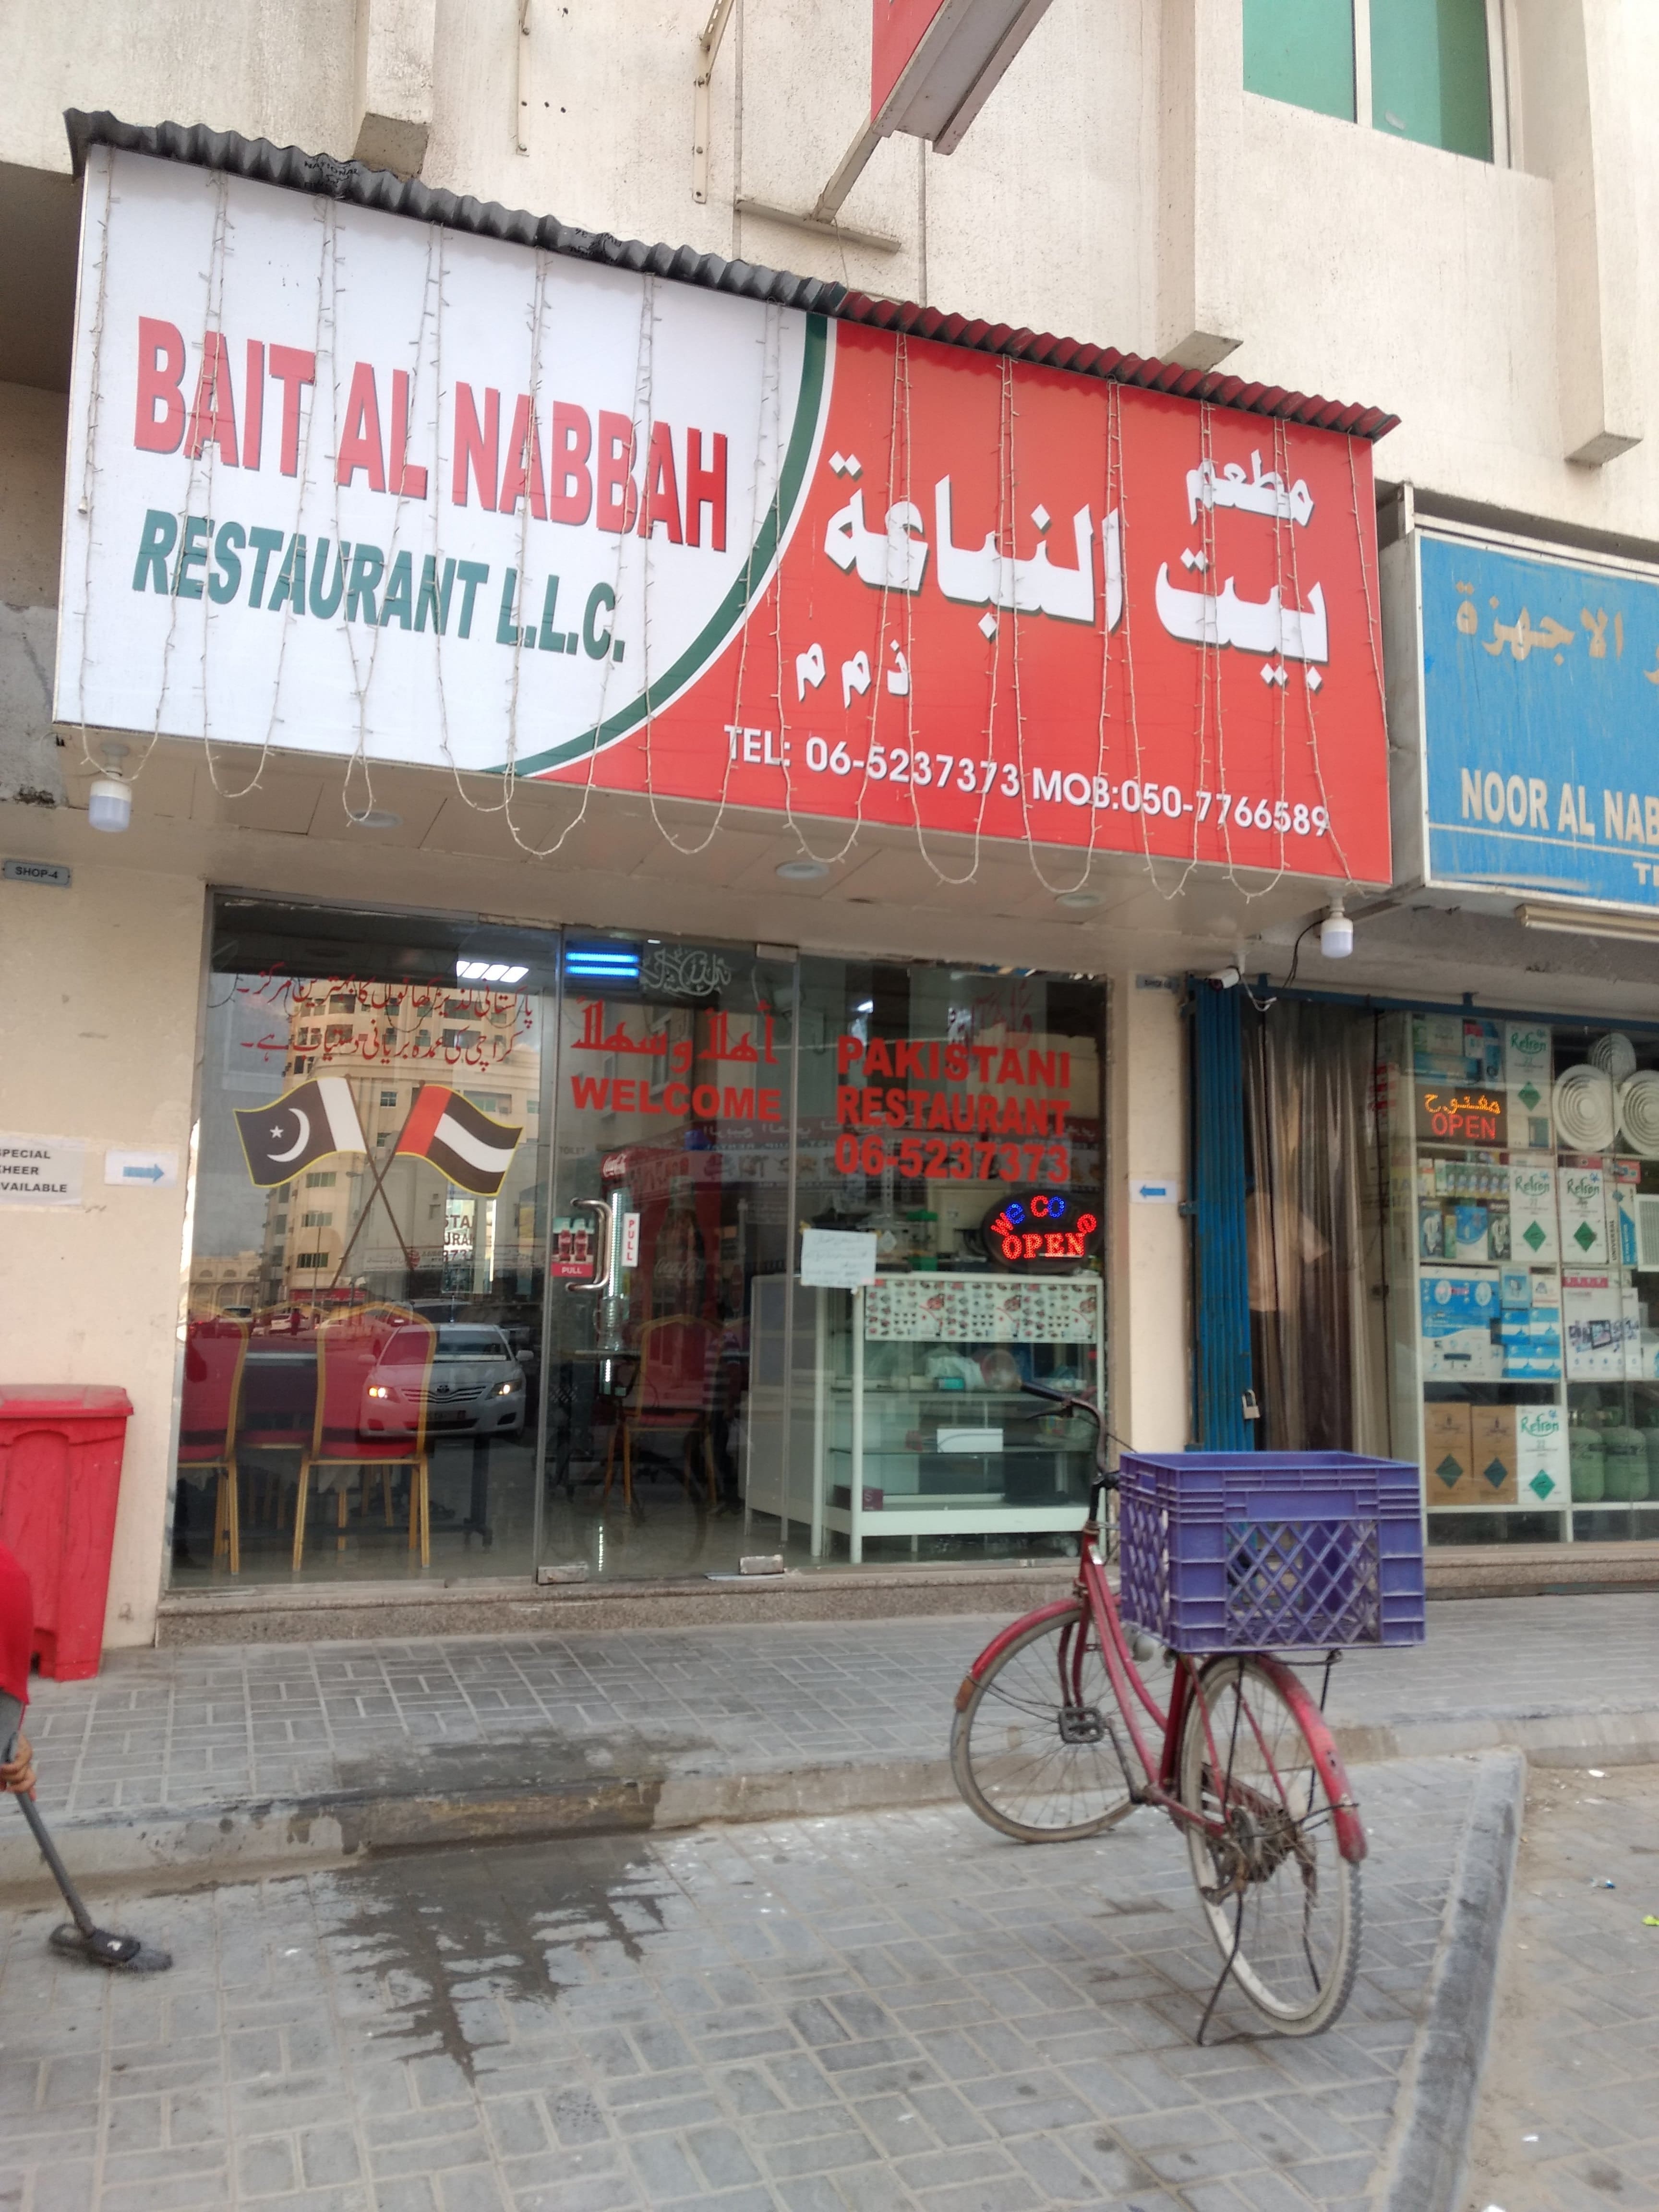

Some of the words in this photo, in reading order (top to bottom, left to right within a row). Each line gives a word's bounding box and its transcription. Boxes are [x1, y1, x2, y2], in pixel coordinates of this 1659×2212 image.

[133, 315, 317, 478] BAIT
[335, 361, 428, 500] AL
[452, 381, 728, 552] NABBAH
[1187, 448, 1314, 527] مطعم
[824, 450, 1122, 640] النباعة
[132, 509, 490, 639] RESTAURANT
[495, 567, 625, 663] L.L.C.
[1155, 547, 1328, 692] بيت
[724, 724, 791, 767] TEL:
[805, 736, 1021, 797] 06-5237373
[1461, 768, 1550, 831] NOOR
[1557, 782, 1595, 837] AL
[1604, 789, 1659, 845] NAB
[15, 866, 58, 879] SHOP-4
[837, 1035, 1071, 1089] PAKISTANI
[571, 1075, 781, 1121] WELCOME
[837, 1085, 1070, 1137] RESTAURANT
[1424, 1095, 1501, 1115] مفتوح
[1431, 1112, 1496, 1140] OPEN
[0, 1149, 51, 1159] PECIAL
[0, 1165, 39, 1175] HEER
[835, 1134, 1070, 1184] 06-5237373
[1, 1182, 67, 1192] VAILABLE
[626, 1220, 635, 1261] PULL
[1001, 1233, 1085, 1260] OPEN
[561, 1266, 583, 1275] PULL
[1521, 1413, 1559, 1437] Refron
